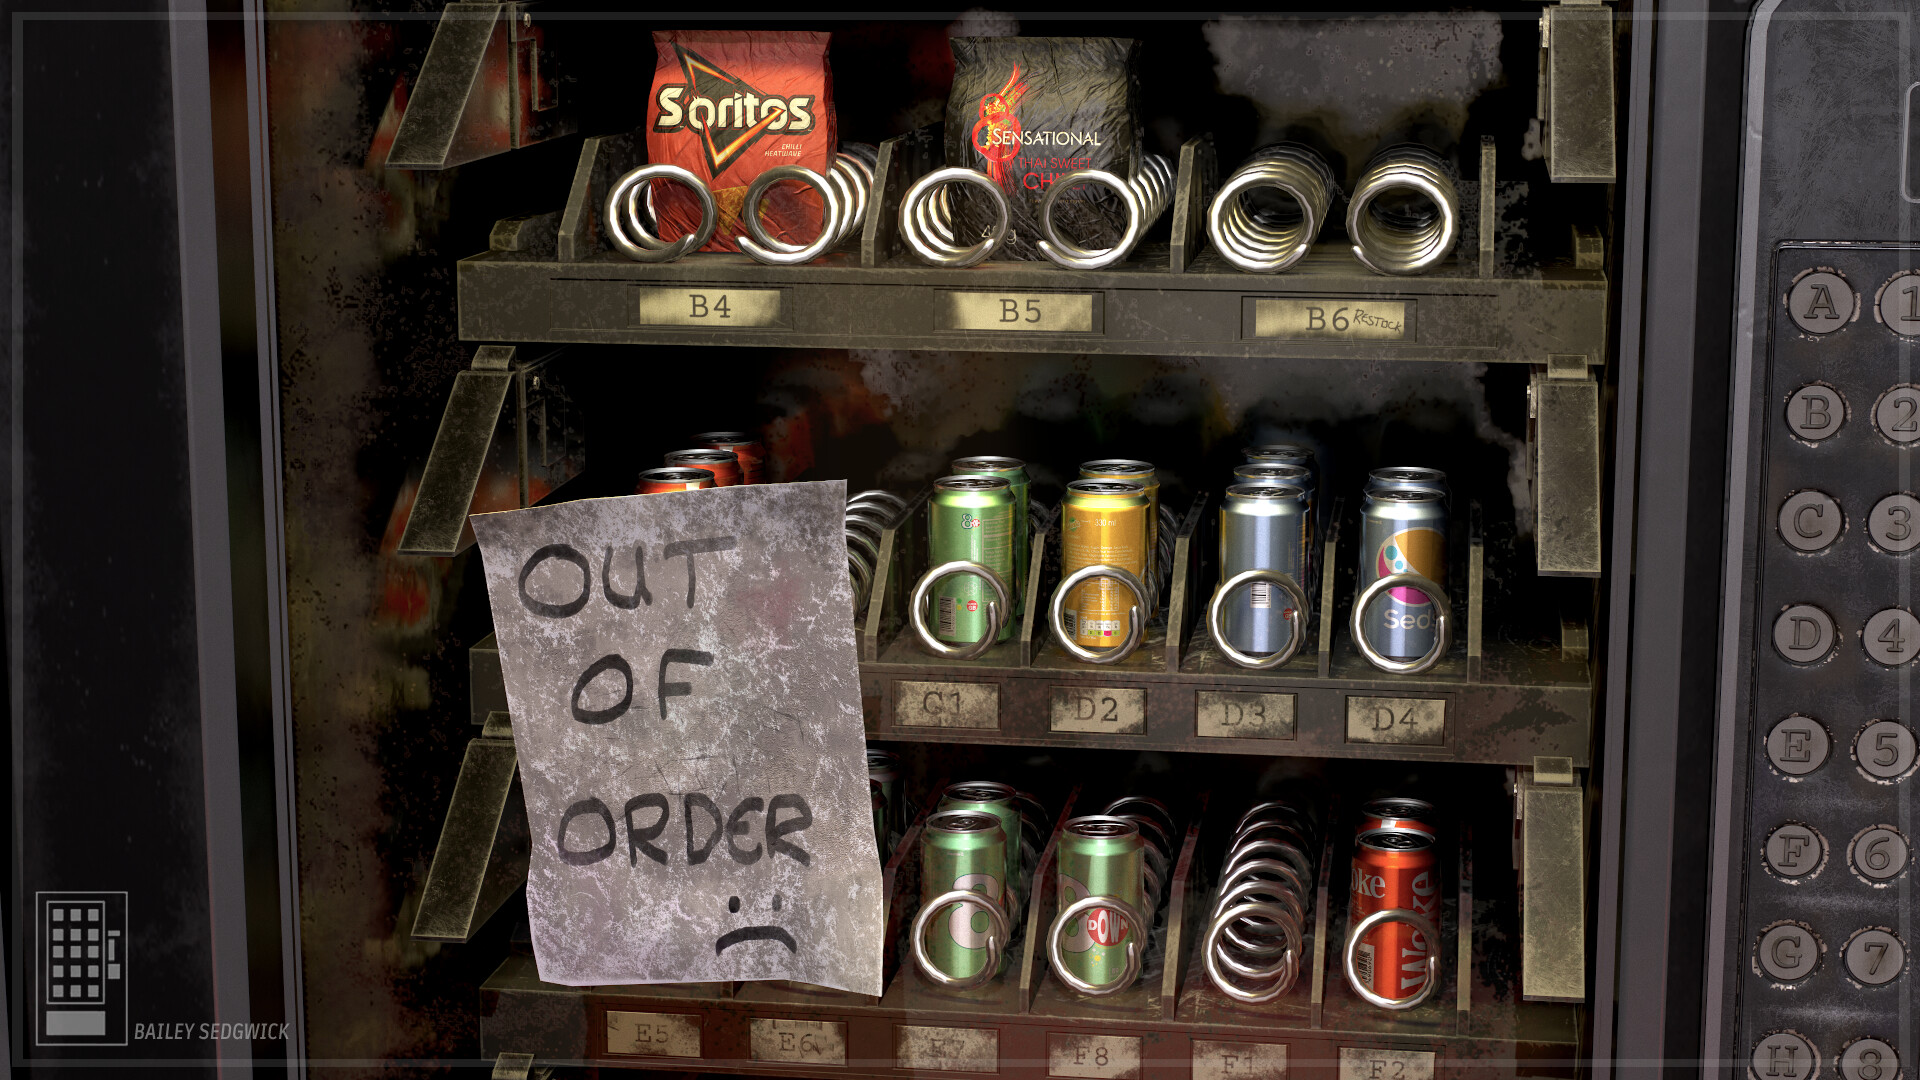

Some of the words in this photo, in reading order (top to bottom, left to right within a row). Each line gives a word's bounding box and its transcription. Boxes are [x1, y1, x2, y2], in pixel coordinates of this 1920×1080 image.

[656, 86, 812, 131] Soritos
[992, 128, 1102, 146] SENSATIONAL
[1018, 157, 1047, 169] THAI
[1050, 157, 1092, 170] SWEET
[688, 294, 732, 319] B4
[999, 298, 1043, 323] B5
[1804, 283, 1840, 320] A
[1901, 286, 1920, 321] 1
[1305, 306, 1350, 332] B6
[1800, 394, 1832, 430] B
[1892, 396, 1918, 432] 2
[1793, 503, 1824, 539] C
[1885, 505, 1912, 541] 3
[518, 536, 737, 618] OUT
[1789, 615, 1821, 650] D
[1877, 618, 1905, 653] 4
[571, 649, 714, 724] OF
[1074, 696, 1119, 722] D2
[1221, 702, 1267, 727] D3
[1372, 707, 1419, 731] D4
[1780, 728, 1811, 762] E
[1873, 732, 1898, 767] 5
[557, 792, 814, 868] ORDER
[1778, 833, 1810, 868] F
[1865, 836, 1890, 870] 6
[1088, 909, 1129, 944] DOWN
[1771, 935, 1803, 969] G
[1864, 941, 1889, 976] 7
[635, 1023, 669, 1044] E5
[779, 1031, 813, 1052] E6
[1073, 1046, 1109, 1067] F8
[1369, 1059, 1406, 1080] F2
[1766, 1044, 1799, 1078] H
[1858, 1048, 1883, 1080] 8
